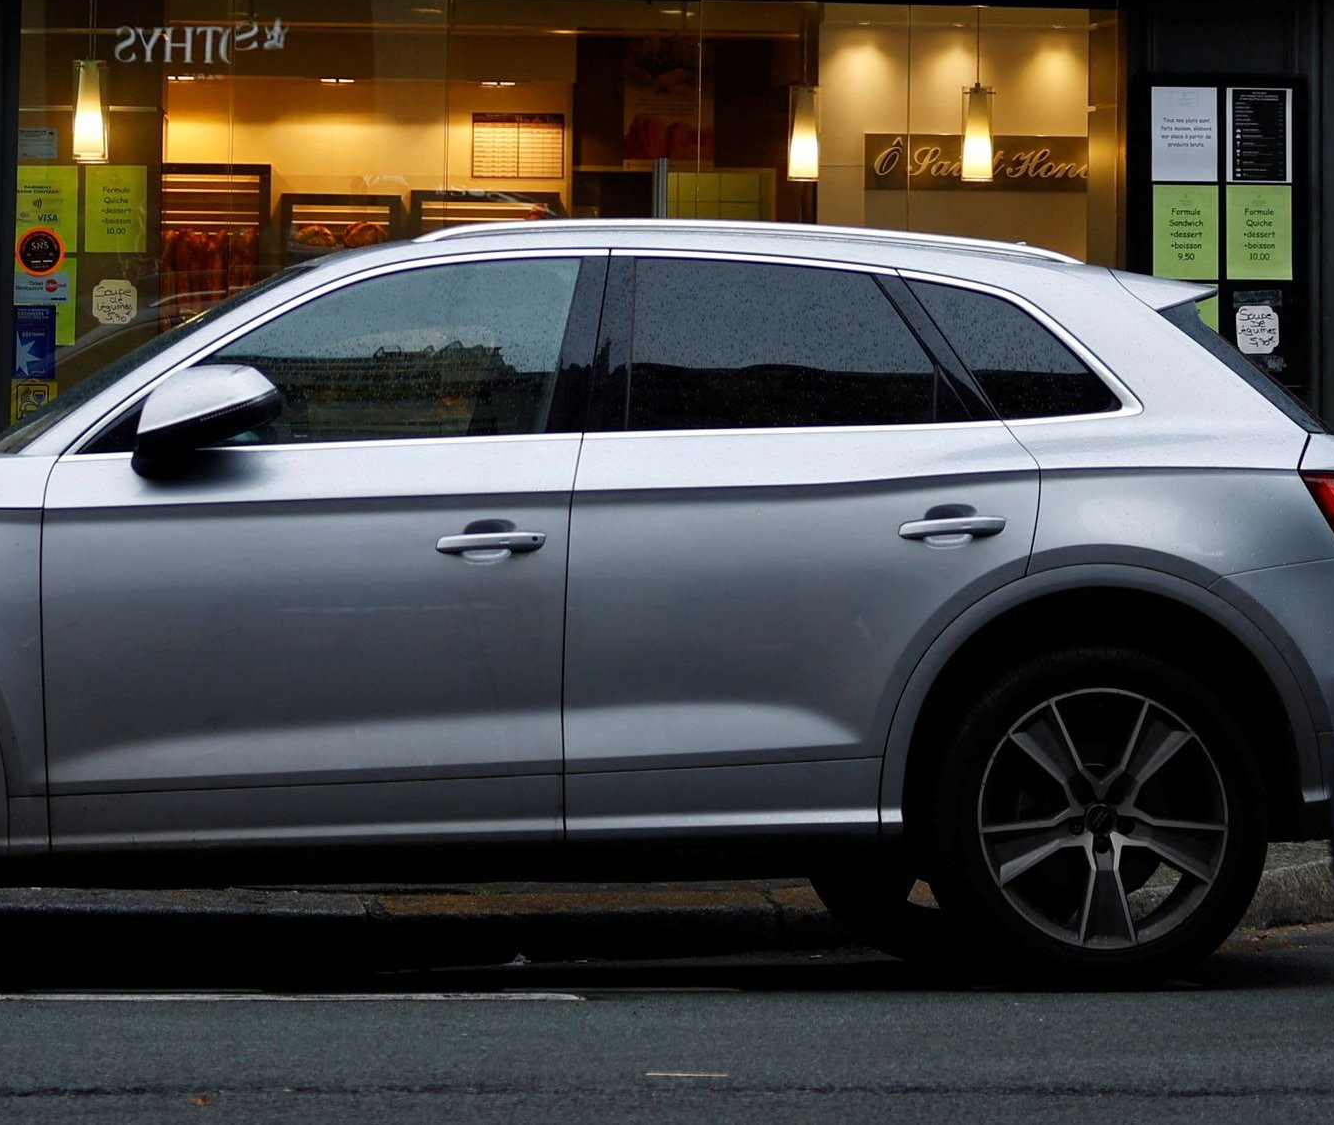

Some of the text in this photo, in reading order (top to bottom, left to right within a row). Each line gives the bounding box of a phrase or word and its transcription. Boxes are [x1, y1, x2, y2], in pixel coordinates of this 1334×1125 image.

[874, 136, 904, 176] Ô
[908, 147, 1005, 177] Sait
[103, 197, 128, 205] Quiche
[1171, 208, 1201, 216] Formule
[1244, 208, 1274, 216] Formule
[38, 214, 58, 222] VISA
[1169, 219, 1204, 227] Sandwich
[1246, 219, 1273, 227] Quiche
